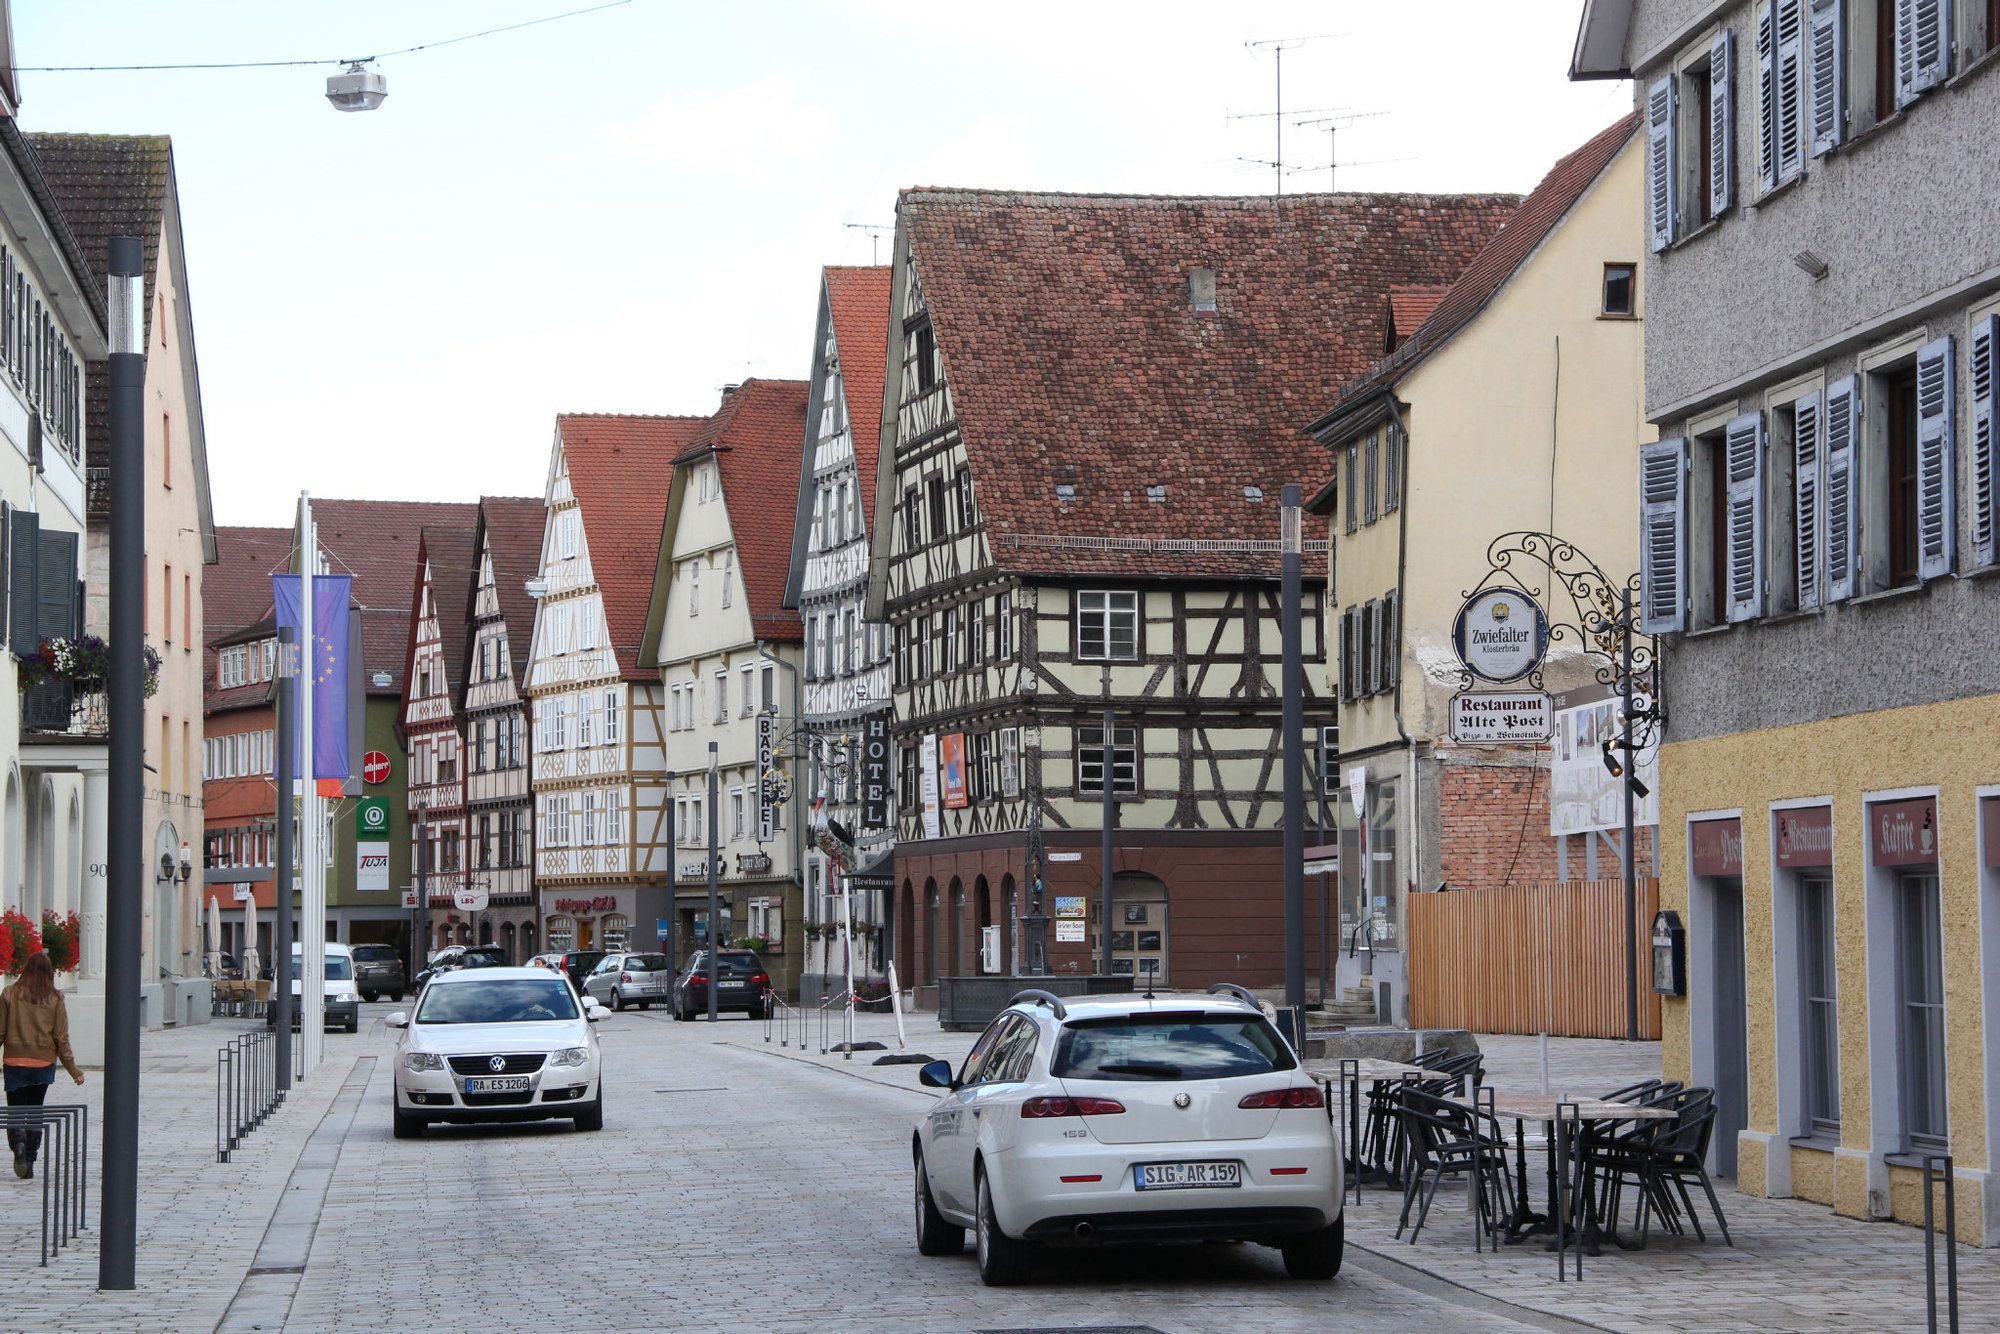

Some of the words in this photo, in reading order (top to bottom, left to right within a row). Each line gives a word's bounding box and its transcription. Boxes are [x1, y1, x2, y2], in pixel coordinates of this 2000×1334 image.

[1472, 627, 1529, 645] Zwiefalter
[1482, 644, 1520, 654] Klosterbräu
[1461, 698, 1543, 711] Restaurant
[1460, 715, 1496, 728] Alte
[1503, 714, 1544, 729] Post
[1497, 731, 1543, 739] Weinstube
[868, 721, 884, 822] HOTEL
[1789, 819, 1832, 852] Restauran
[1881, 812, 1914, 859] Kaffee
[360, 855, 388, 869] TUJA
[90, 863, 108, 877] 90
[853, 877, 894, 886] Restauran
[473, 1080, 485, 1091] RA
[491, 1079, 503, 1090] ES
[505, 1078, 528, 1089] 1206
[1062, 1130, 1087, 1138] 159
[1146, 1166, 1176, 1183] SIG
[1187, 1165, 1207, 1182] AR
[1209, 1165, 1237, 1181] 159
